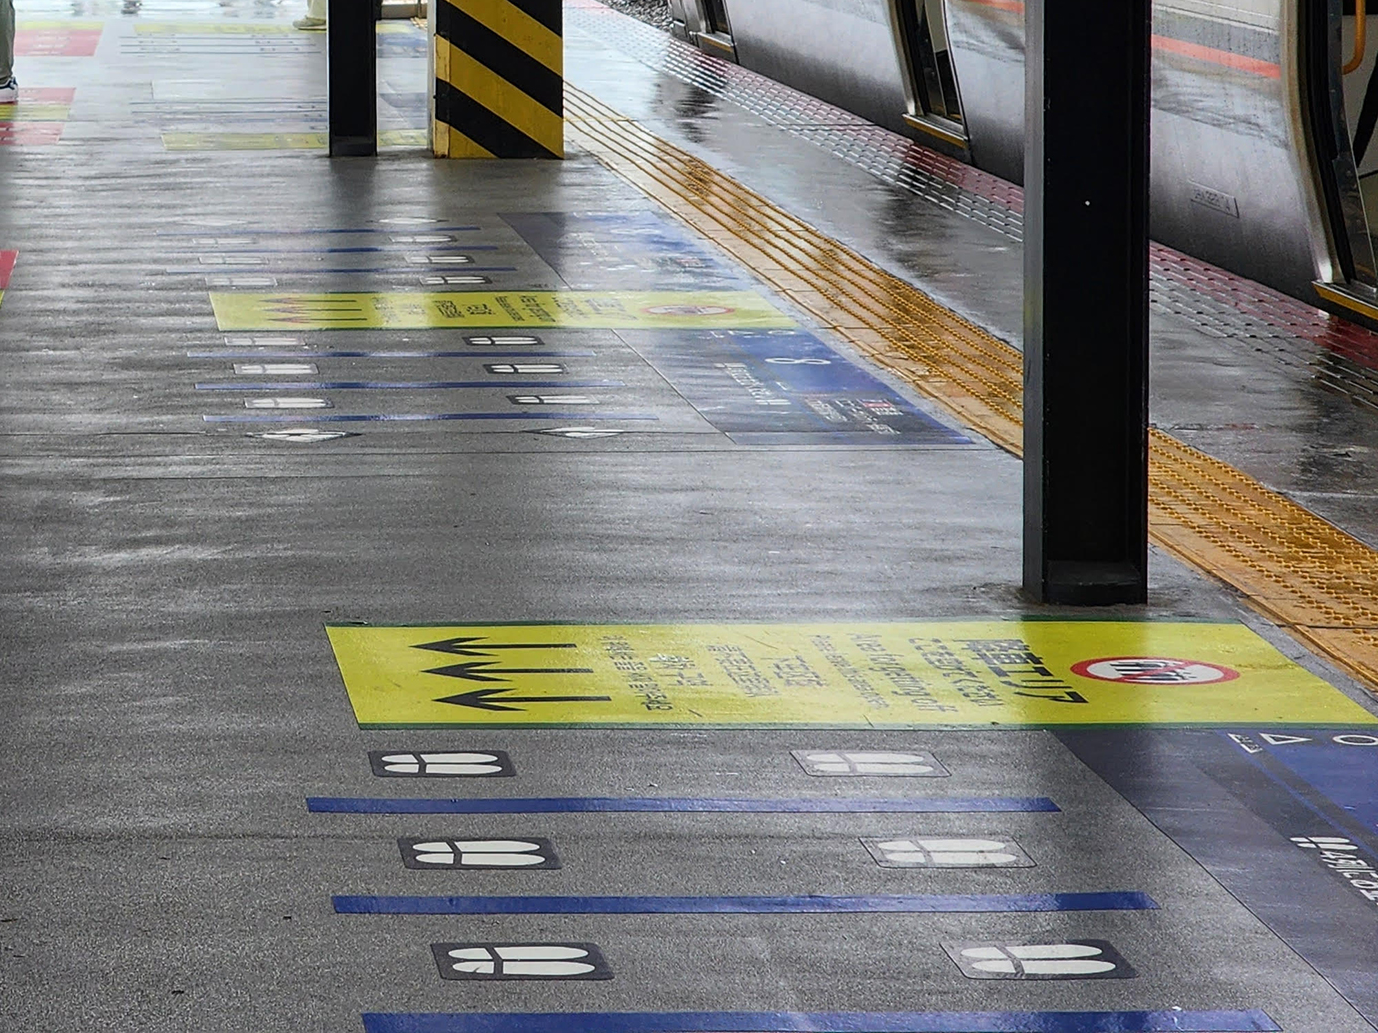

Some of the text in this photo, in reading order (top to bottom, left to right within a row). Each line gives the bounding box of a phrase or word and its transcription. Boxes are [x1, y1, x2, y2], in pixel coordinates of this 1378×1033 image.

[845, 633, 961, 713] Area for getting off
[950, 638, 1096, 704] 降車エリア
